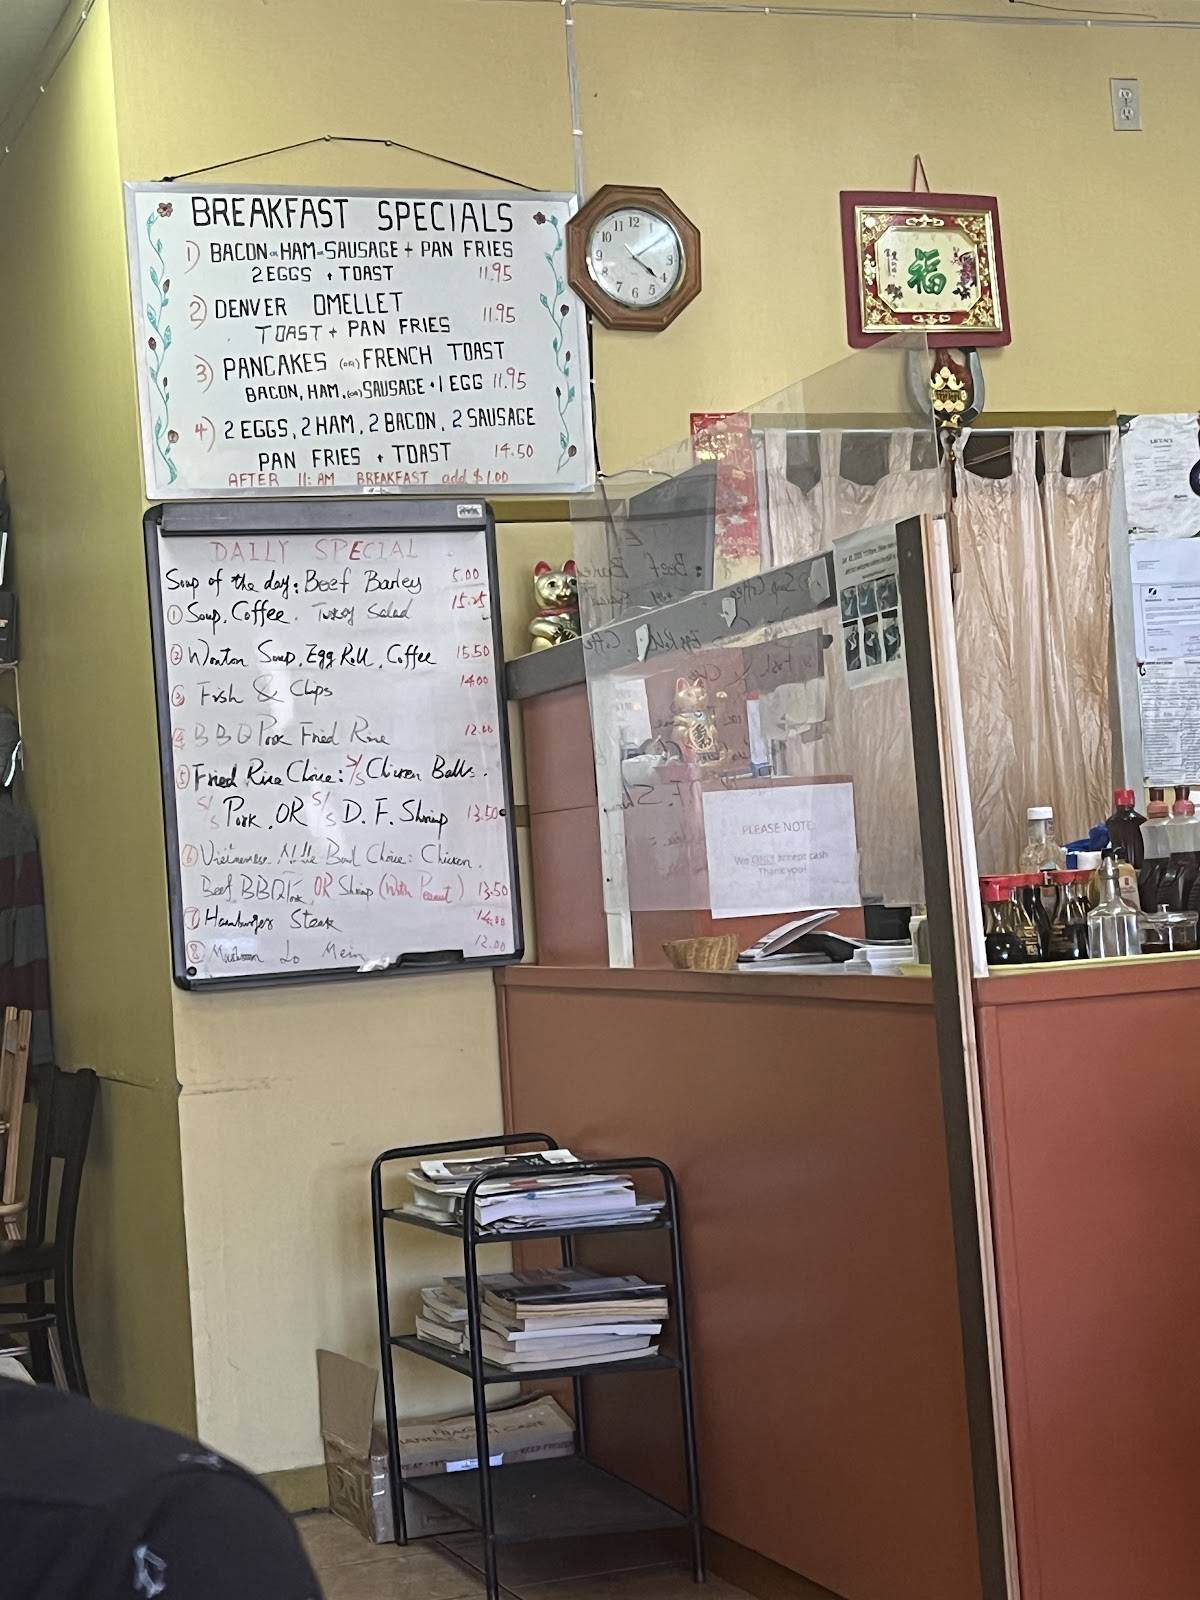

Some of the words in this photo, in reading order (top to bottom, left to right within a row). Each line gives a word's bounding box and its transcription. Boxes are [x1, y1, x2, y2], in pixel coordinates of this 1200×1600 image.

[191, 196, 349, 229] BREAKFAST
[377, 200, 514, 233] SPECIALS
[628, 216, 640, 228] 12
[601, 231, 612, 243] 10
[613, 220, 624, 232] 11
[210, 242, 268, 263] BACON
[280, 241, 316, 260] HAM
[324, 240, 398, 260] SAUSAGE
[404, 241, 413, 258] +
[421, 240, 453, 258] PAN
[463, 240, 514, 258] FRIES
[595, 250, 603, 261] 9
[666, 255, 674, 266] 3
[338, 265, 394, 282] TOAST
[479, 262, 513, 283] 11.95
[602, 267, 608, 276] 8
[660, 272, 667, 283] 4
[907, 247, 947, 296] 福
[616, 281, 623, 293] 7
[631, 287, 639, 298] 6
[648, 284, 656, 295] 5
[215, 297, 287, 319] DENVER
[313, 291, 403, 316] OMELLET
[482, 303, 516, 324] 11.95
[254, 324, 323, 345] TOAST
[348, 319, 386, 338] PAN
[399, 316, 450, 335] FRIES
[223, 352, 327, 381] PANCAKES
[363, 345, 433, 370] FRENCH
[446, 341, 505, 362] TOAST
[245, 383, 304, 403] BACON,
[362, 377, 425, 399] SAUSAGE
[449, 373, 483, 392] EGG
[493, 367, 528, 391] 11.95
[466, 407, 537, 428] SAUSAGE
[258, 450, 297, 472] PAN
[312, 447, 361, 468] FRIES
[391, 442, 452, 464] TOAST
[494, 442, 535, 460] 14.50
[228, 472, 280, 488] AFTER
[317, 472, 336, 486] AM
[356, 470, 429, 486] BREAKFAST
[441, 468, 467, 485] add
[208, 539, 290, 564] DAILY
[314, 538, 419, 561] SPECIAL
[165, 567, 200, 600] Soup
[208, 567, 224, 598] of
[231, 572, 260, 593] the
[304, 566, 352, 594] Beef
[364, 567, 423, 595] Barley
[451, 567, 480, 583] 5.00
[367, 598, 414, 620] Salad
[305, 643, 337, 670] Egg
[386, 643, 438, 670] Coffee
[196, 680, 245, 706] Fish
[252, 673, 285, 703] &
[289, 677, 334, 706] Chips
[192, 763, 238, 792] Fried
[246, 757, 285, 787] Rice
[275, 795, 309, 827] OR
[741, 823, 781, 835] PLEASE
[313, 872, 334, 898] OR
